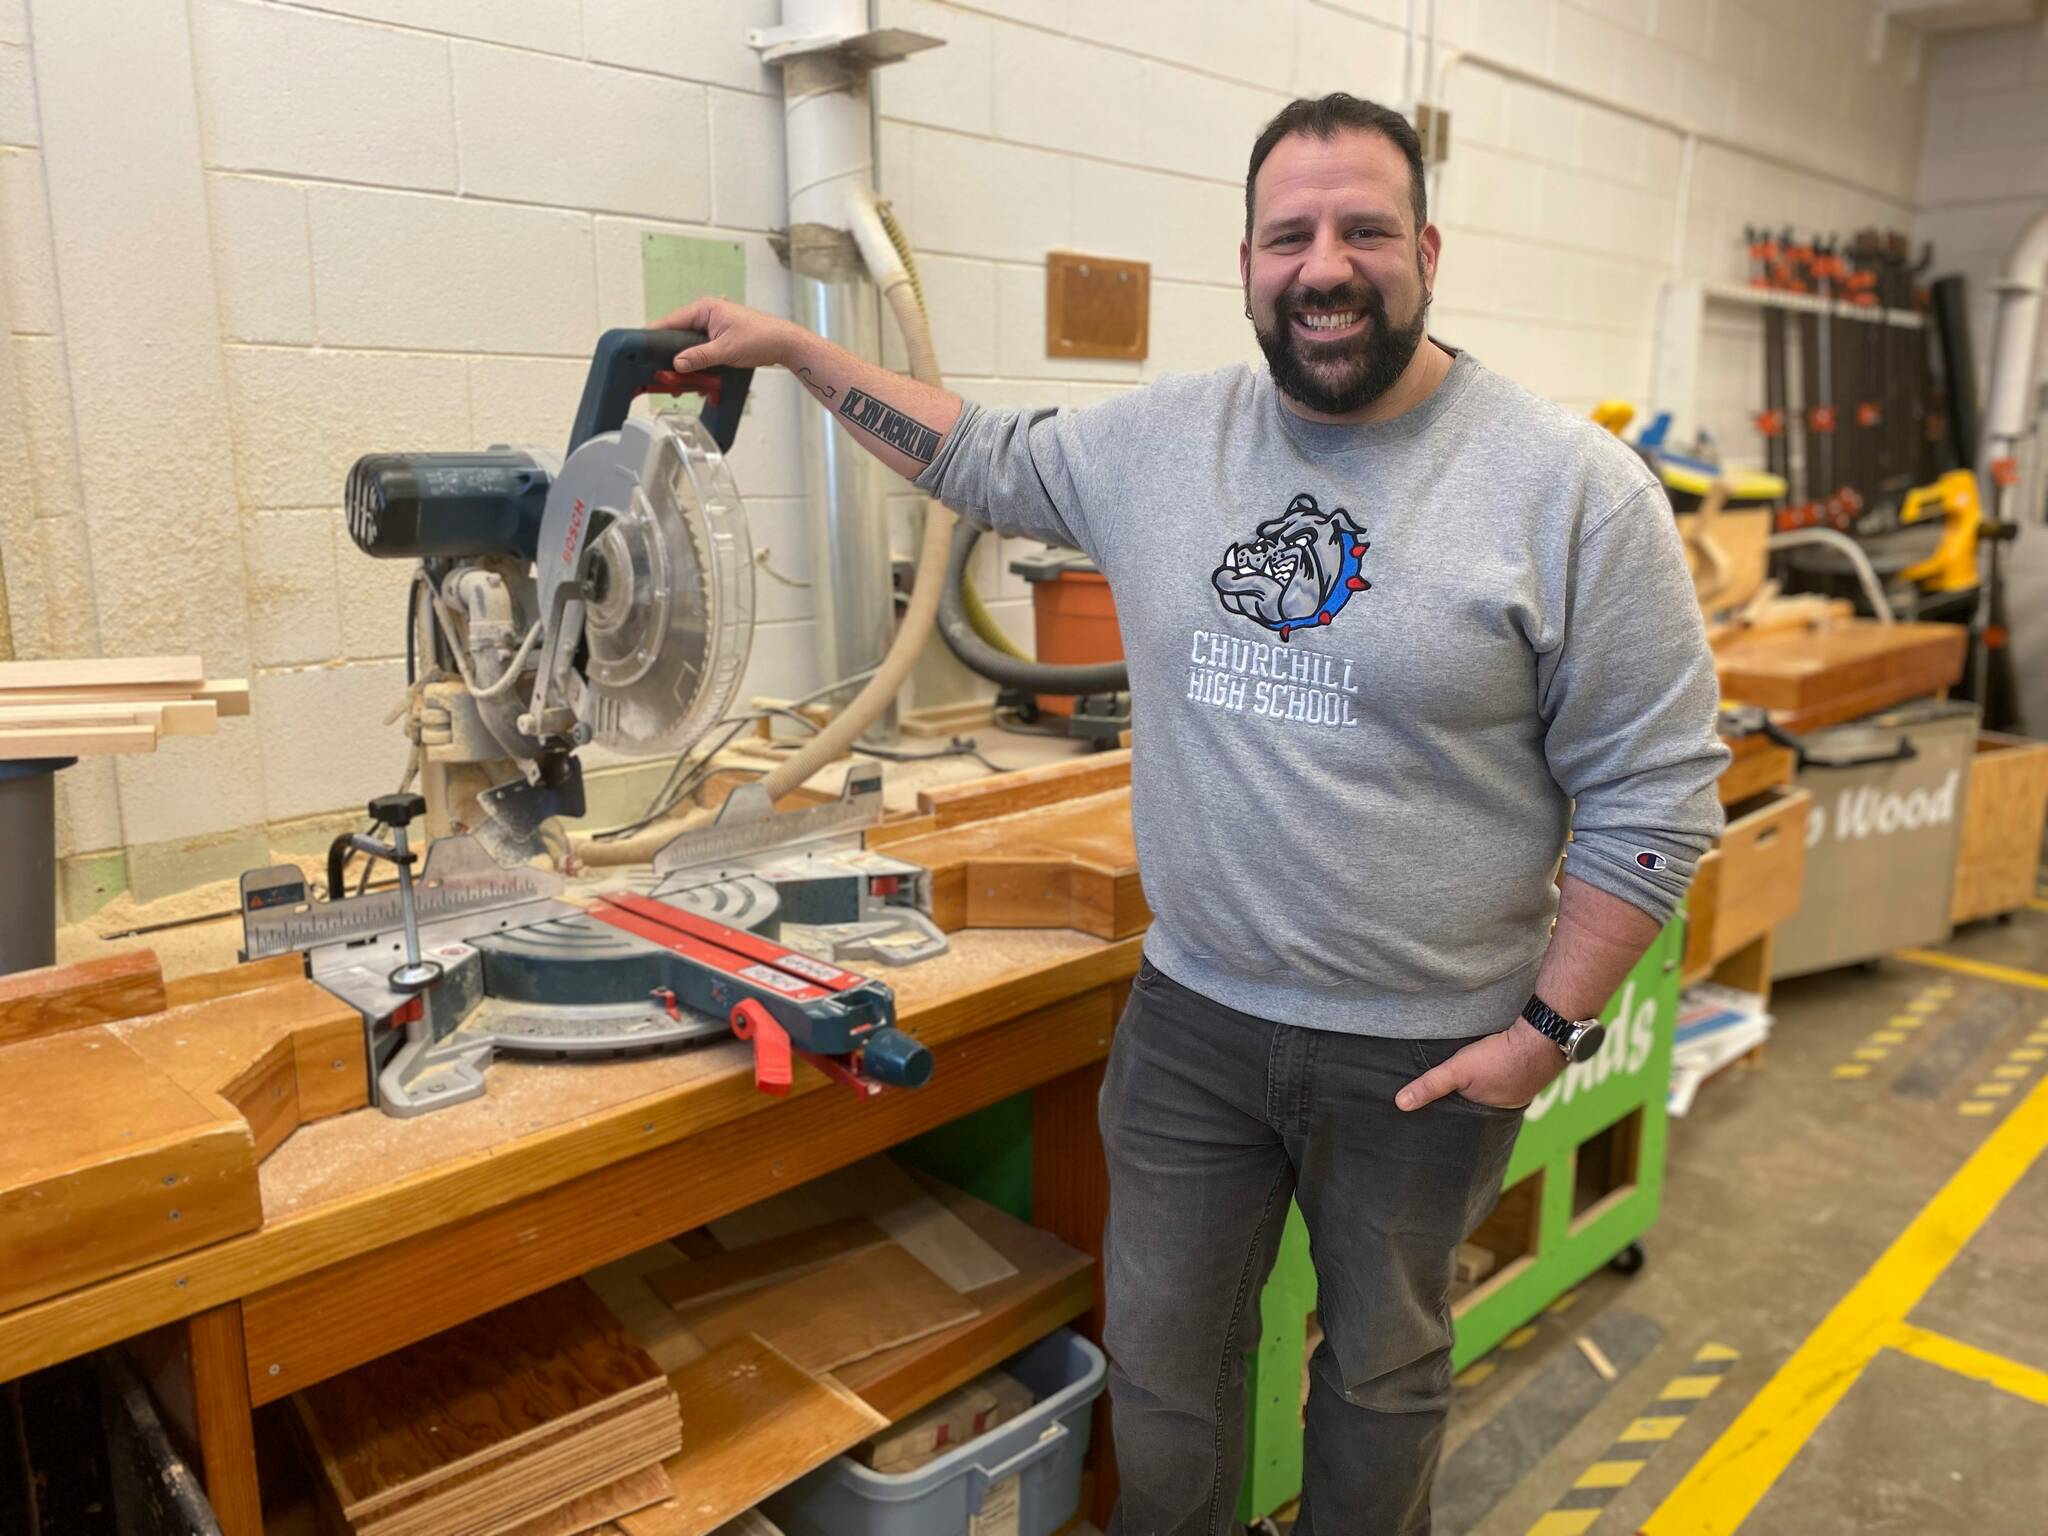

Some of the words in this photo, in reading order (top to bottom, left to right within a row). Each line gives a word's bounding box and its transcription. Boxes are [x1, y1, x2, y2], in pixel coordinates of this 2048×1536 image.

[562, 498, 585, 565] BOSCH
[1191, 631, 1358, 694] CHURCHILL
[1187, 666, 1248, 711] HIGH
[1253, 681, 1357, 727] SCHOOL
[1835, 768, 1960, 841] Wood
